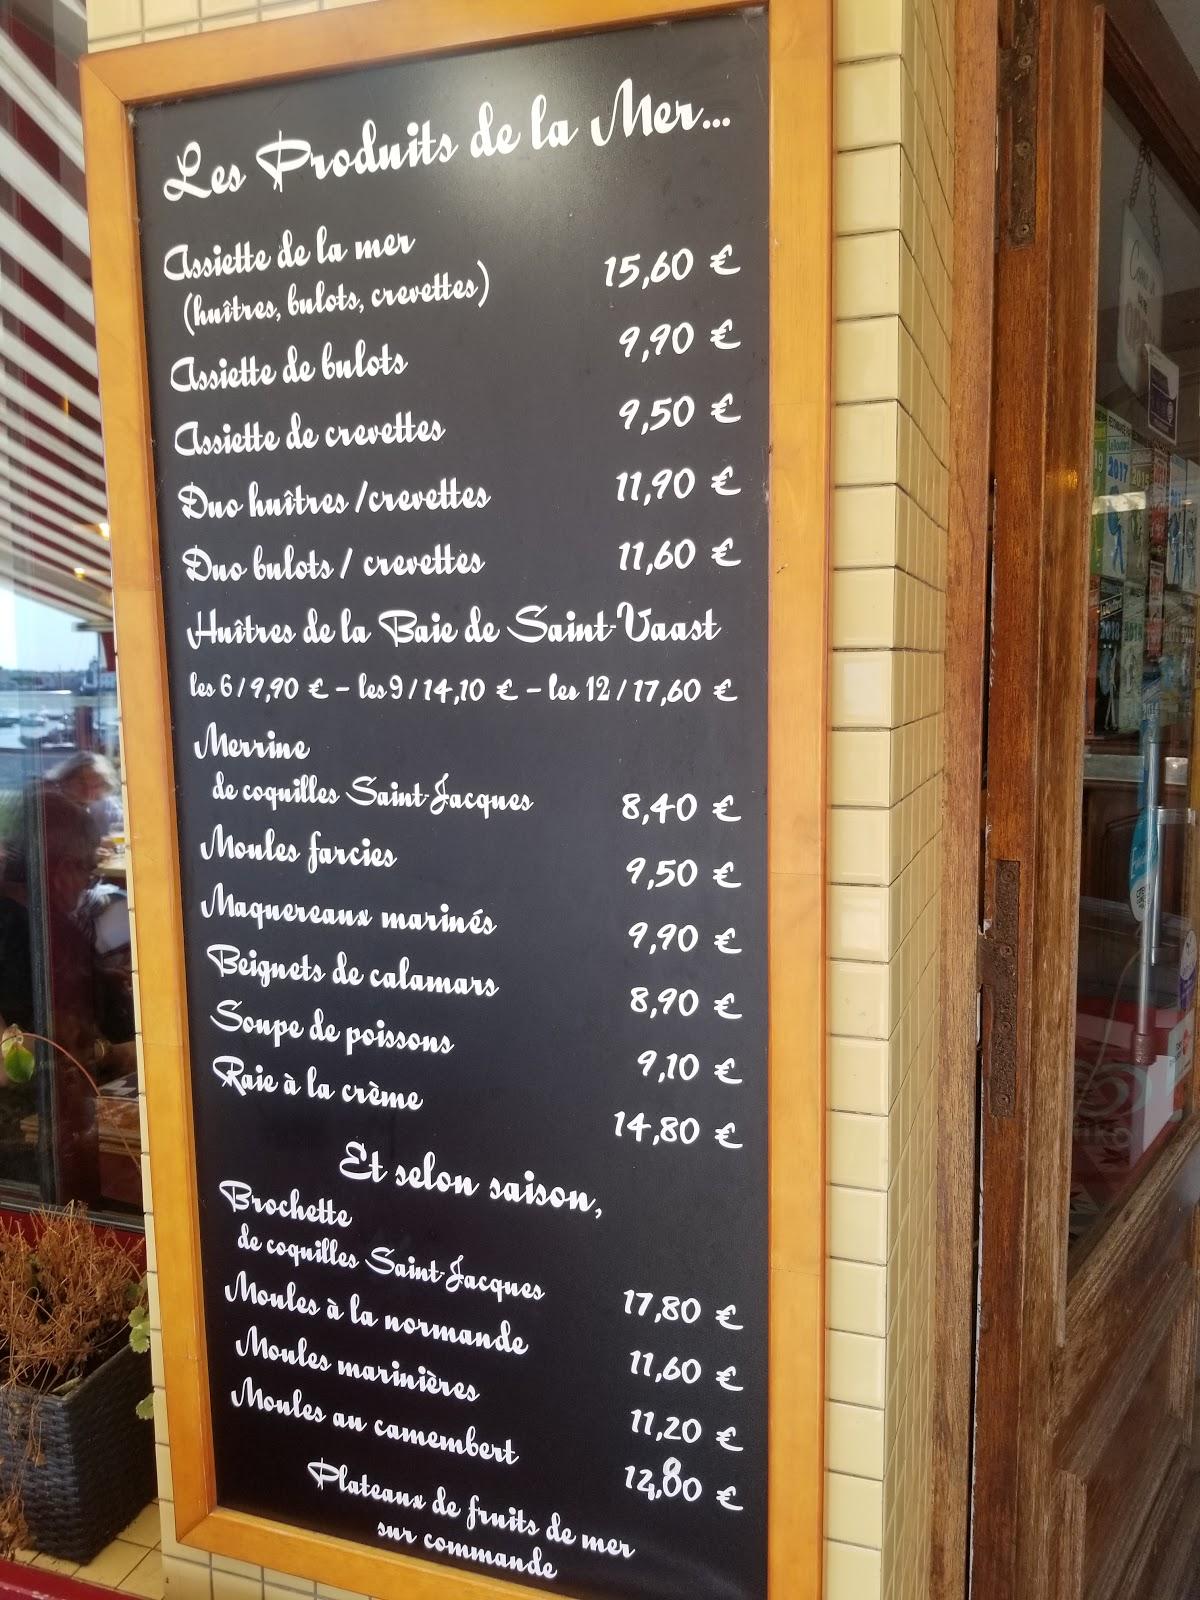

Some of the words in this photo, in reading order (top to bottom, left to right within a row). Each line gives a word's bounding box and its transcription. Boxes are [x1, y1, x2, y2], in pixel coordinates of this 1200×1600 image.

[163, 141, 246, 202] Les
[256, 118, 459, 193] Produits
[470, 101, 521, 159] de
[531, 94, 579, 147] la
[590, 77, 732, 147] Mer...
[163, 240, 272, 282] Assiette
[276, 228, 312, 269] de
[316, 224, 349, 265] la
[354, 232, 417, 261] mer
[603, 247, 694, 289] 15,60
[709, 243, 742, 276] €
[183, 291, 284, 337] (huîtres,
[287, 280, 366, 317] bulots,
[370, 259, 490, 309] crevettes)
[618, 321, 695, 364] 9,90
[709, 318, 742, 350] €
[169, 354, 278, 393] Assiette
[282, 344, 317, 384] de
[321, 338, 409, 381] bulots
[174, 420, 281, 457] Assiette
[285, 411, 320, 450] de
[324, 410, 447, 448] crevettes
[618, 394, 696, 436] 9,50
[710, 392, 742, 424] €
[615, 466, 696, 507] 11,90
[710, 465, 742, 496] €
[1107, 455, 1129, 483] 2017
[177, 481, 244, 520] Duo
[248, 480, 350, 518] huîtres
[181, 544, 248, 582] Duo
[363, 543, 486, 577] crevettes
[618, 538, 697, 576] 11,60
[710, 536, 742, 567] €
[187, 607, 297, 650] Huîtres
[302, 607, 337, 644] de
[340, 607, 372, 644] la
[377, 609, 459, 648] Baie
[464, 605, 501, 643] de
[189, 671, 217, 698] les
[307, 677, 330, 699] €
[357, 672, 388, 700] les
[495, 678, 519, 702] €
[548, 672, 581, 701] les
[712, 678, 739, 702] €
[211, 770, 239, 801] de
[241, 773, 341, 812] coquilles
[345, 772, 535, 820] Saint-Jacques
[621, 792, 698, 826] 8,40
[711, 794, 742, 823] €
[199, 823, 302, 863] Moules
[307, 830, 399, 875] farcies
[625, 856, 699, 891] 9,50
[712, 860, 742, 889] €
[200, 882, 374, 931] Maquereaux
[381, 902, 498, 936] marinés
[627, 921, 699, 959] 9,90
[713, 927, 743, 955] €
[206, 943, 327, 988] Beignets
[331, 950, 365, 986] de
[369, 955, 500, 998] calamars
[630, 986, 700, 1019] 8,90
[713, 992, 743, 1020] €
[209, 999, 305, 1048] Soupe
[308, 1007, 341, 1043] de
[345, 1019, 456, 1057] poissons
[212, 1055, 279, 1097] Raie
[283, 1072, 302, 1096] à
[306, 1065, 336, 1101] la
[341, 1080, 424, 1111] crème
[636, 1049, 700, 1084] 9,10
[713, 1057, 743, 1085] €
[613, 1110, 701, 1146] 14,80
[714, 1121, 744, 1150] €
[338, 1140, 389, 1184] Et
[394, 1150, 481, 1197] selon
[488, 1169, 603, 1220] saison,
[218, 1179, 353, 1228] Brochette
[237, 1222, 263, 1252] de
[266, 1237, 360, 1270] coquilles
[364, 1246, 546, 1304] Saint-Jacques
[224, 1270, 321, 1316] Moules
[326, 1297, 345, 1321] à
[349, 1292, 379, 1328] la
[384, 1314, 530, 1356] normande
[623, 1288, 702, 1324] 17,80
[714, 1304, 744, 1331] €
[235, 1324, 333, 1372] Moules
[337, 1359, 481, 1403] marinières
[629, 1349, 702, 1385] 11,60
[715, 1365, 744, 1392] €
[230, 1376, 327, 1424] Moules
[332, 1411, 368, 1433] au
[373, 1419, 520, 1466] camembert
[630, 1408, 703, 1444] 11,20
[715, 1426, 744, 1452] €
[306, 1456, 427, 1511] Plateaux
[431, 1485, 462, 1519] de
[466, 1494, 541, 1537] fruits
[545, 1511, 577, 1546] de
[581, 1533, 636, 1560] mer
[715, 1485, 744, 1512] €
[376, 1521, 418, 1545] sur
[423, 1532, 558, 1580] commande
